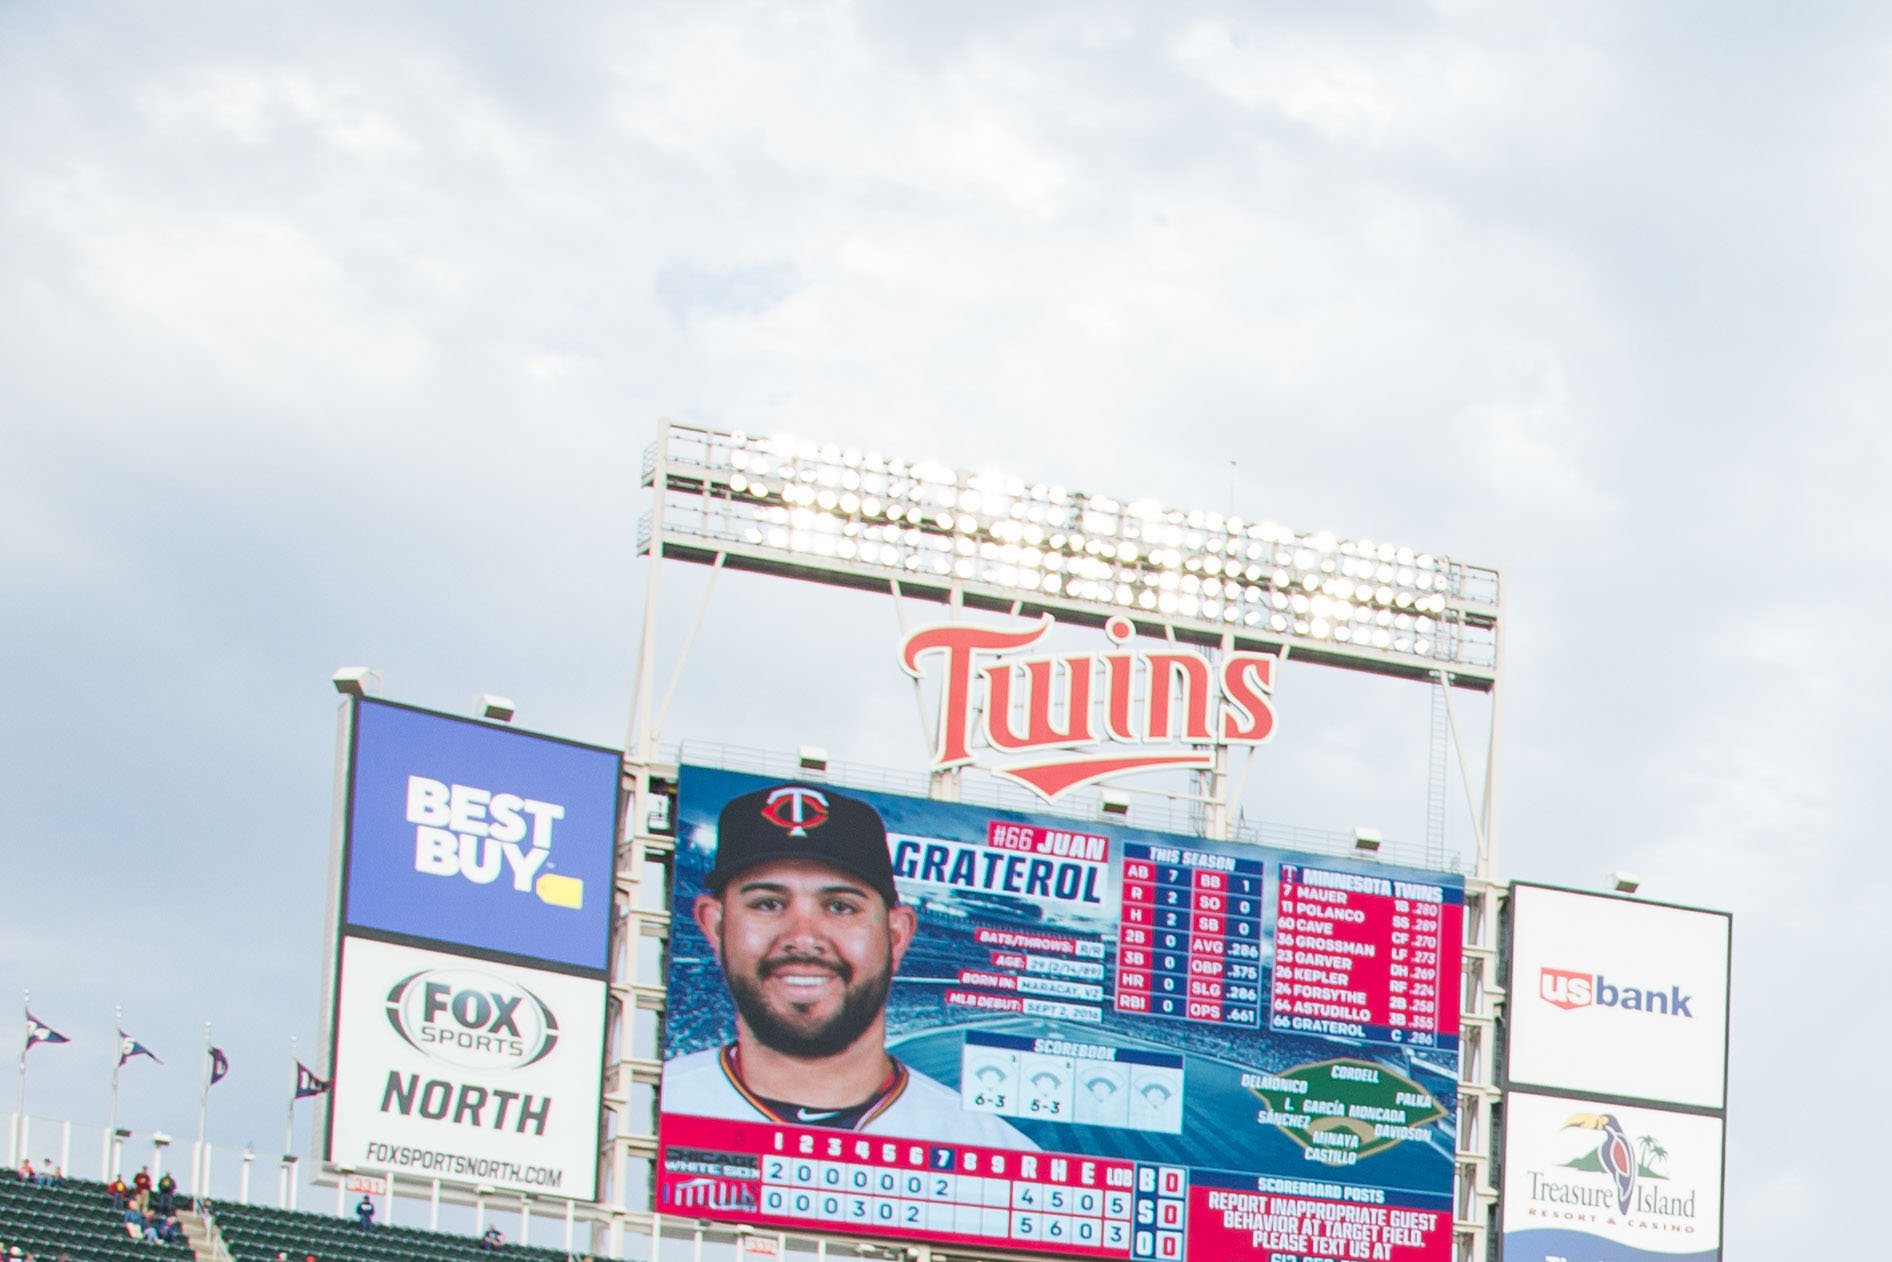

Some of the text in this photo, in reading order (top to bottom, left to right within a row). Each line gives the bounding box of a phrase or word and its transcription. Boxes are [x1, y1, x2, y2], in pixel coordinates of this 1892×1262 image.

[899, 612, 1279, 774] Twins
[406, 775, 564, 849] BEST
[993, 824, 1105, 860] #66 JUAN
[415, 825, 549, 892] BUY
[1150, 847, 1236, 871] THIS SEASON
[894, 840, 1101, 903] GRATEROL
[1297, 886, 1347, 904] MAUER
[1303, 868, 1443, 902] MINNESOTA TWINS
[1297, 903, 1365, 923] POLANCO
[1297, 919, 1333, 935] CAVE
[1193, 938, 1258, 958] AVG .286
[1296, 935, 1375, 956] GROSSMAN
[1192, 960, 1257, 980] OBP .375
[1295, 951, 1352, 969] GARVER
[1294, 968, 1348, 986] KEPLER
[1294, 984, 1367, 1005] FORSYTHE
[424, 981, 522, 1037] FOX
[1191, 1003, 1255, 1022] OPS .661
[1294, 1001, 1372, 1021] ASTUDILLO
[1293, 1017, 1366, 1037] GRATEROL
[421, 1026, 523, 1056] SPORTS
[1241, 1074, 1308, 1094] DELMONICO
[1331, 1065, 1379, 1083] CORDELL
[380, 1070, 551, 1136] NORTH
[1303, 1099, 1344, 1116] GARCÍA
[1396, 1092, 1432, 1108] PALKA
[1349, 1105, 1406, 1123] MONCADA
[1313, 1131, 1359, 1149] MINAYA
[1374, 1124, 1432, 1141] DAVIDSON
[367, 1142, 562, 1187] FOXSPORTSNORTH.COM
[1305, 1147, 1357, 1166] CASTILLO
[1107, 1167, 1133, 1187] LOB
[1258, 1176, 1385, 1204] SCOREBOARD POSTS
[1528, 1170, 1696, 1219] Treasure Island
[1209, 1191, 1437, 1231] REPORT INAPPROPRIATE GUEST
[1529, 1207, 1696, 1233] RESORT CASINO
[1224, 1210, 1425, 1248] BEHAVIOR AT TARGET FIELD.
[1253, 1230, 1393, 1261] PLEASE TEXT US AT
